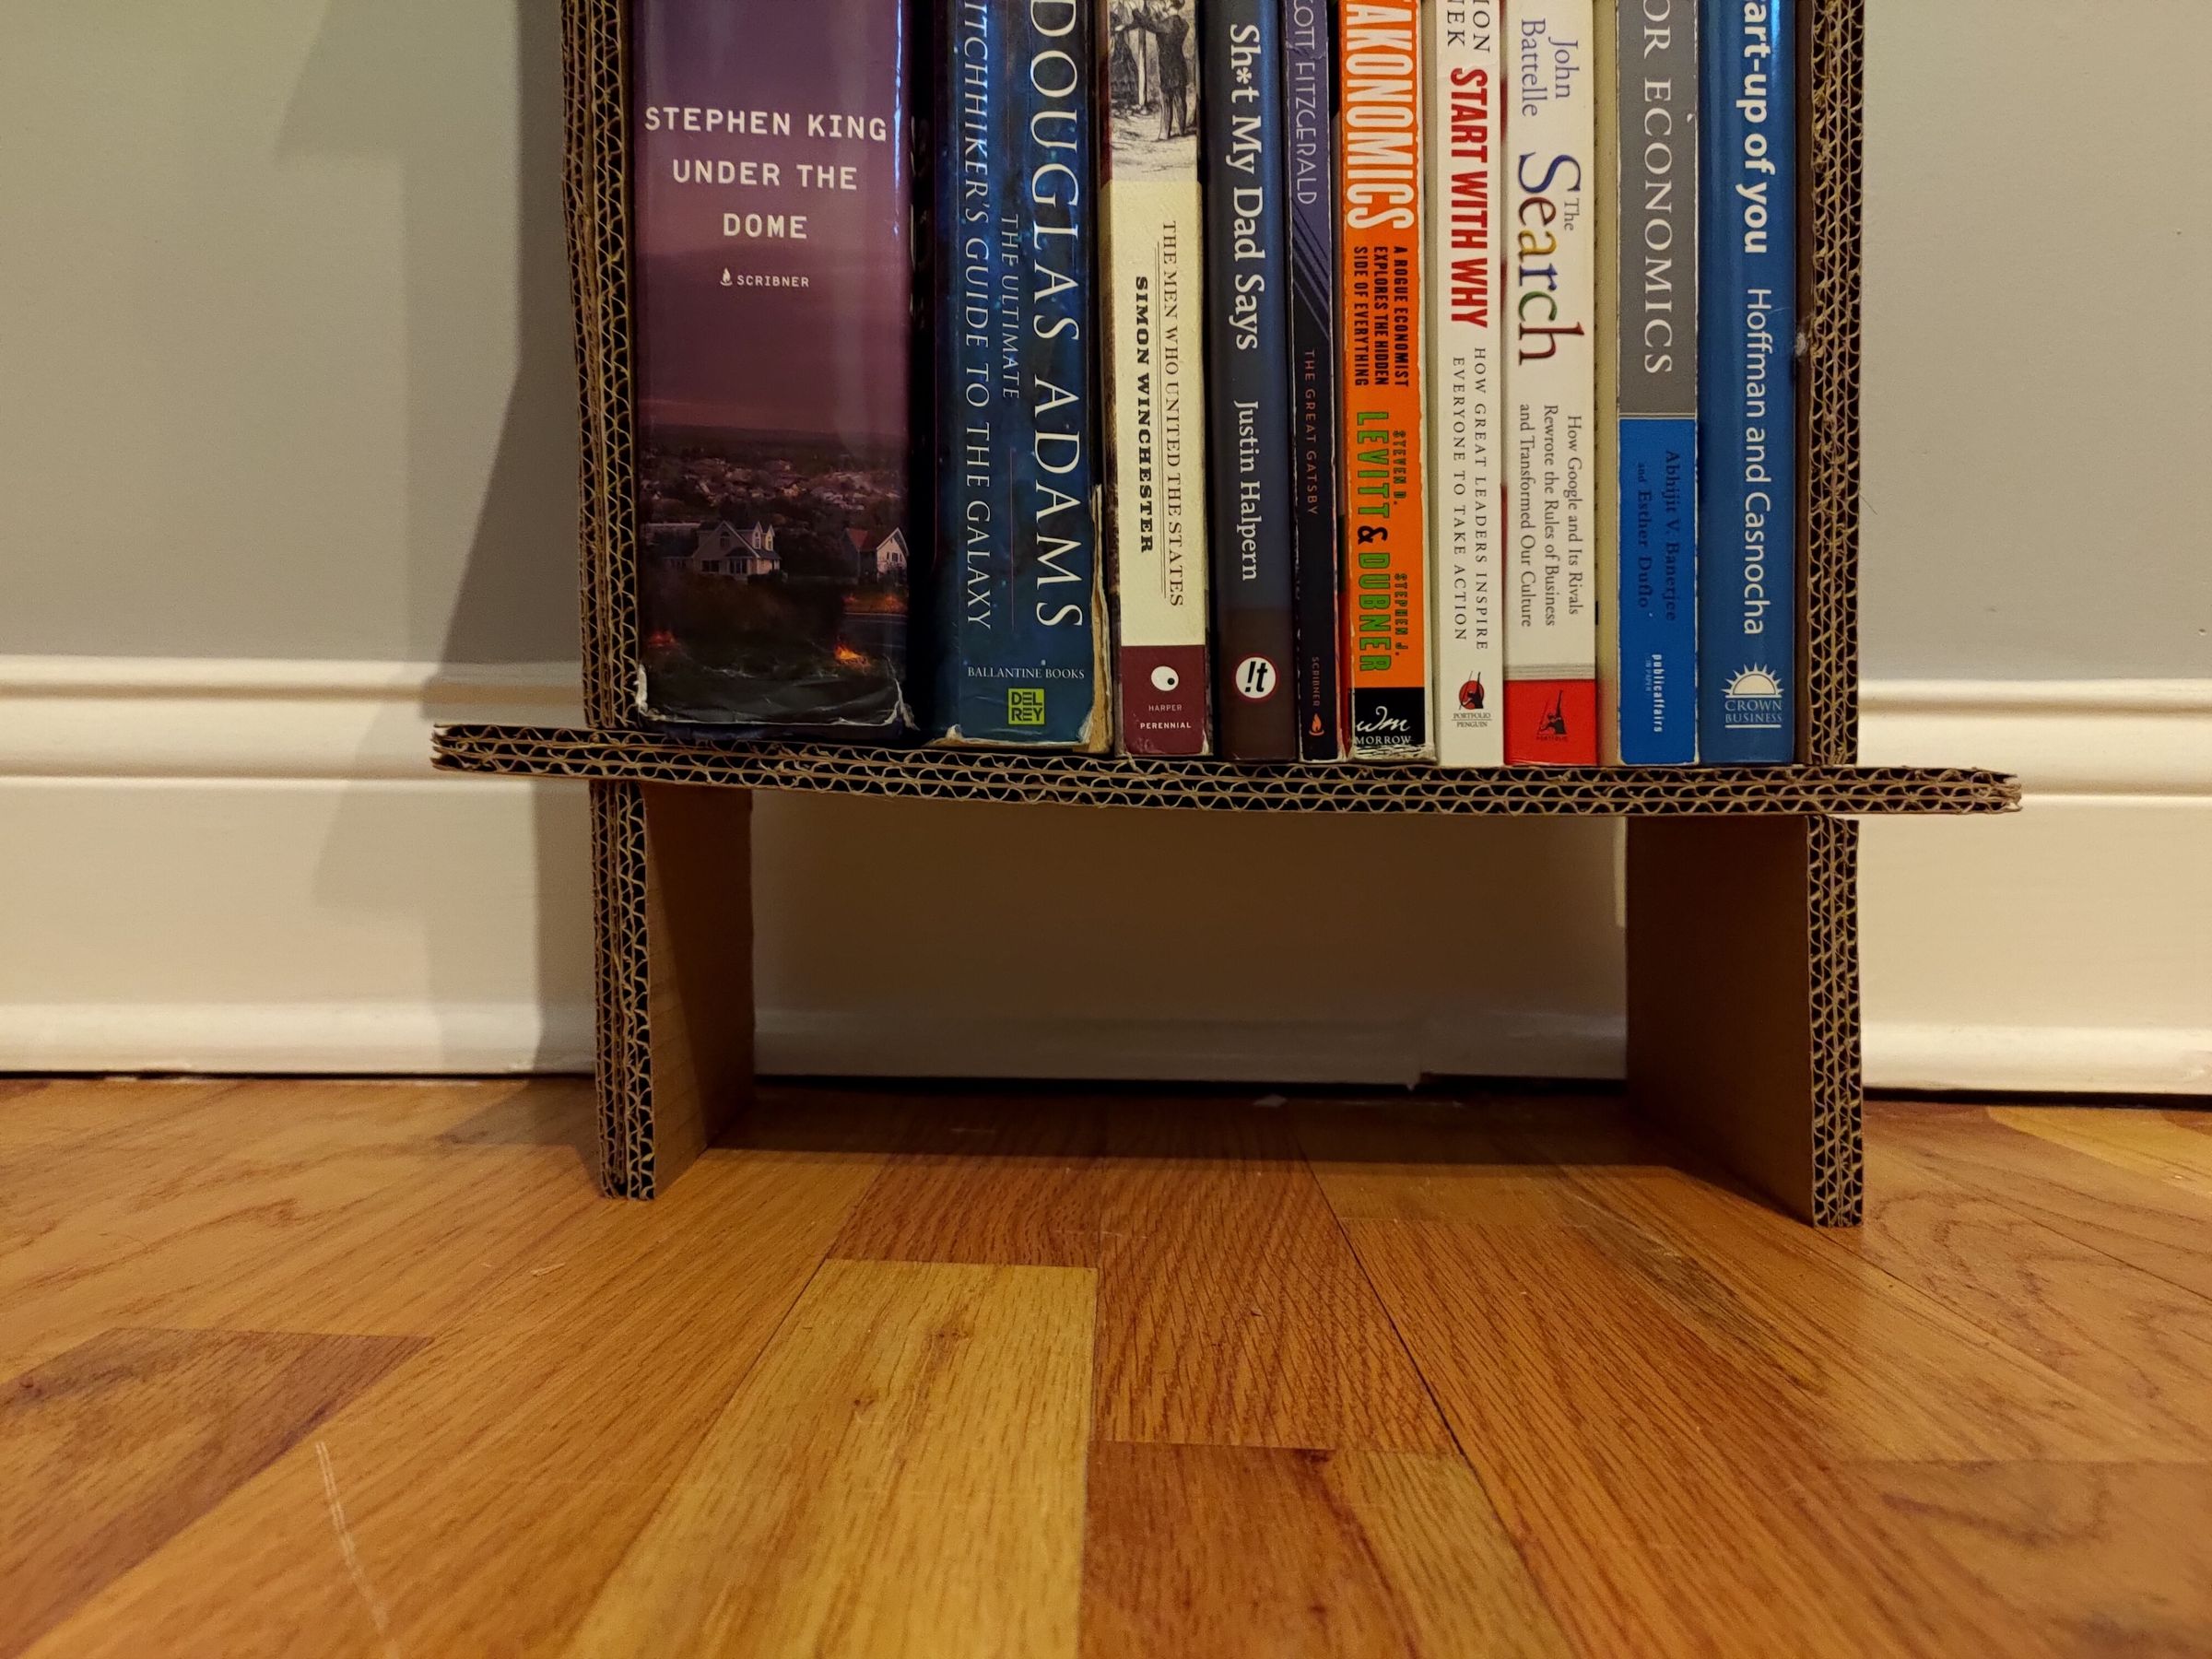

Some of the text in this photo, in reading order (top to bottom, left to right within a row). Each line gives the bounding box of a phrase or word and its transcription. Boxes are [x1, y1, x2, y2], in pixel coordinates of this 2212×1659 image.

[1521, 18, 1547, 117] Battelle
[1548, 36, 1580, 99] John
[645, 107, 887, 141] STEPHEN KING
[1226, 115, 1262, 174] My
[1295, 62, 1317, 205] FITZGERALD
[1346, 0, 1415, 229] AKONOMICS
[1735, 0, 1776, 253] art-up of you
[673, 159, 857, 190] UNDER THE
[1451, 67, 1488, 329] START WITH WHY
[1564, 198, 1581, 230] The
[723, 213, 808, 239] DOME
[1233, 186, 1265, 262] Dad
[1518, 151, 1584, 366] Search
[1643, 77, 1673, 373] ECONOMICS
[736, 275, 809, 288] SCRIBNER
[964, 238, 989, 347] GUIDE
[1001, 214, 1019, 399] THE ULTIMATE
[1030, 0, 1083, 628] DOUGLAS ADAMS
[1229, 274, 1265, 350] Says
[1354, 246, 1369, 386] SIDE OF EVERYTHING
[1374, 246, 1389, 385] EXPLORES THE HIDDEN
[1394, 259, 1408, 302] ROGUE
[965, 362, 990, 407] TO
[1394, 307, 1408, 387] ECONOMIST
[1135, 276, 1153, 553] SIMON WINCHESTER
[1163, 220, 1183, 606] THE MEN WHO UNITED THE STATES
[1304, 349, 1318, 516] THE GREAT GATSBY
[966, 422, 990, 488] THE
[1233, 400, 1262, 582] Justin Halpern
[1393, 430, 1406, 484] STEVEN
[1662, 450, 1680, 512] Abhijit
[1744, 288, 1773, 634] Hoffman and Casnocha
[1453, 357, 1467, 641] EVERYONE TO TAKE ACTION
[1475, 347, 1488, 650] HOW GREAT LEADERS INSPIRE
[1520, 404, 1536, 628] and Transformed Our Culture
[1544, 405, 1560, 627] Rewrote the Rules of Business
[1563, 416, 1583, 615] How Google and Its Rivals
[1637, 462, 1653, 608] and Esther Duflo
[966, 500, 991, 629] GALAXY
[1357, 411, 1391, 672] LEVITT & DUBNER
[1662, 542, 1680, 621] Banerjee
[1394, 573, 1408, 655] STEPHEN J.
[968, 666, 1085, 679] BALLANTINE BOOKS
[1010, 690, 1042, 705] DEL
[1148, 704, 1182, 712] HARPER
[1312, 656, 1320, 707] SCRIBNER
[1652, 653, 1665, 733] publicaffairs
[1724, 700, 1783, 712] CROWN
[1010, 706, 1044, 722] REY
[1140, 722, 1192, 730] PERENNIAL
[1356, 735, 1411, 745] MORROW
[1724, 713, 1783, 724] BUSINESS
